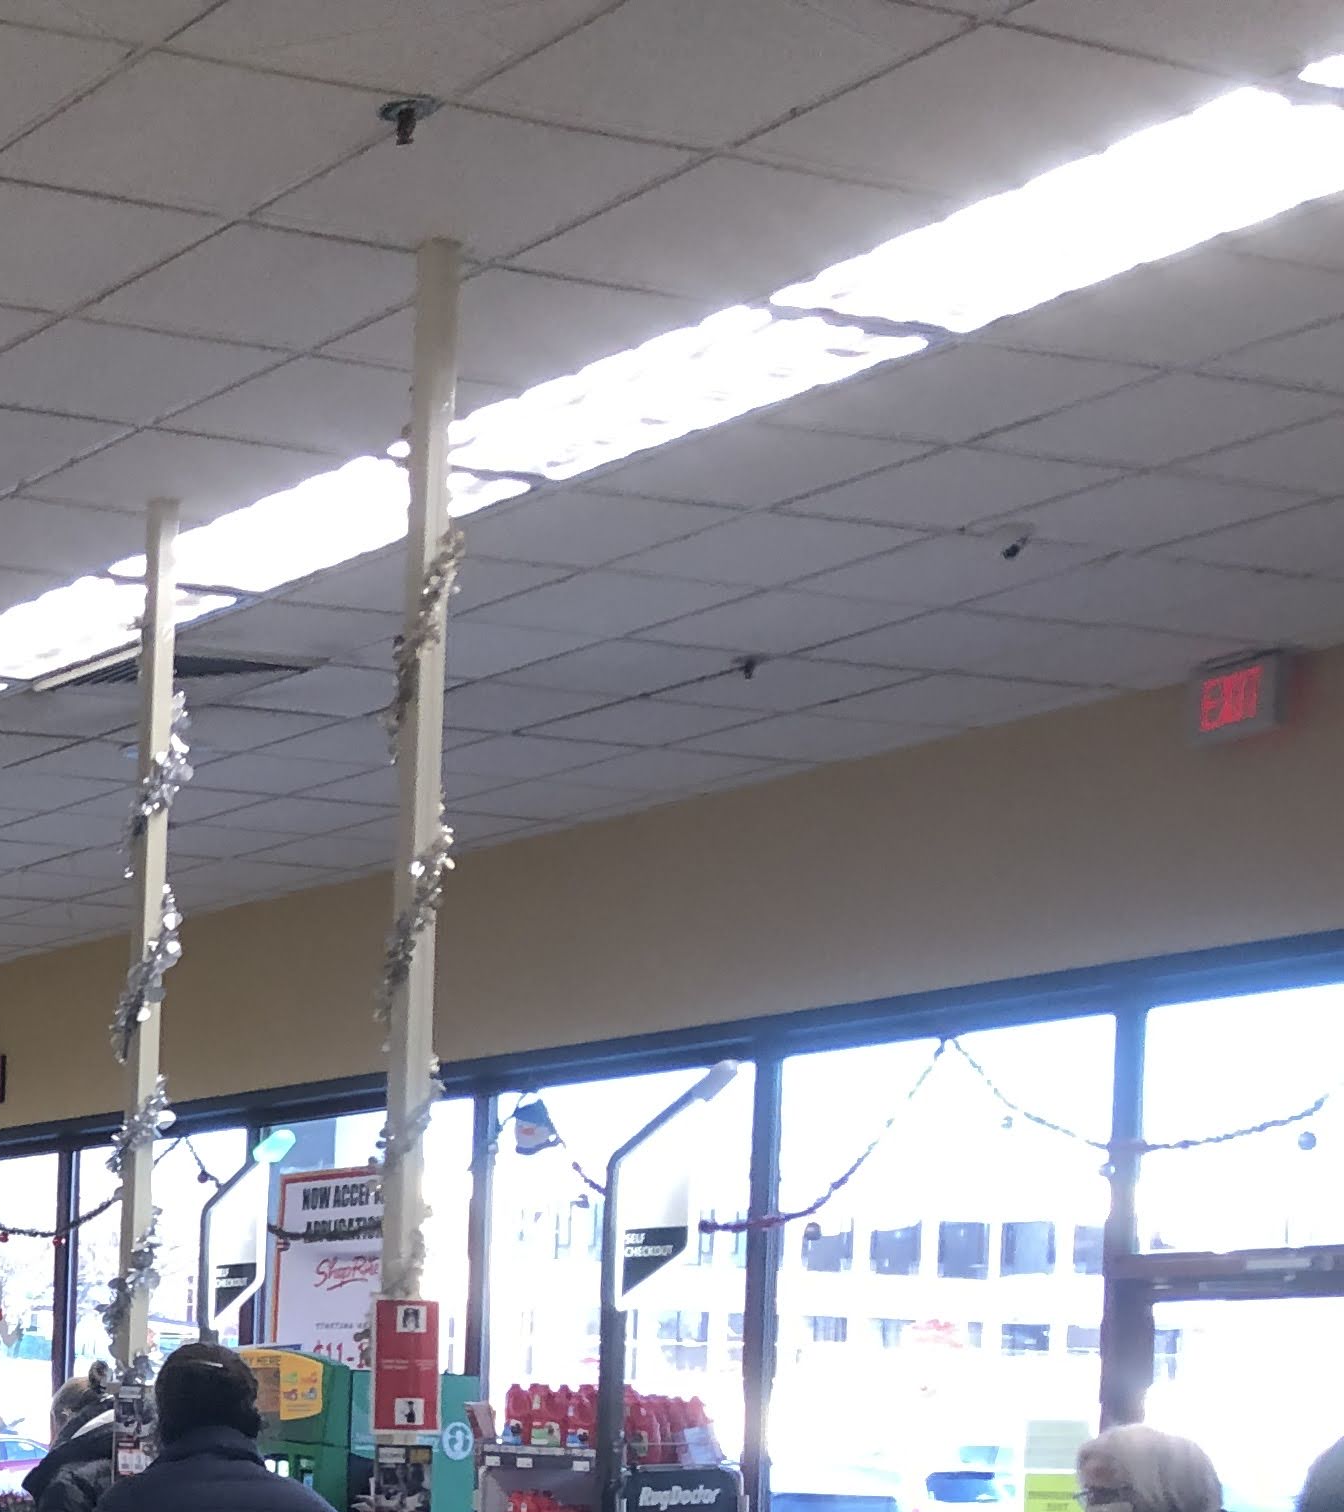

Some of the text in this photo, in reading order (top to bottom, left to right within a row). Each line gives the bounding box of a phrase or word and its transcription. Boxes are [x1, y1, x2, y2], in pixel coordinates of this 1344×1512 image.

[1200, 665, 1263, 732] EXIT
[301, 1185, 331, 1211] NOW
[624, 1245, 673, 1257] CHECKOUT
